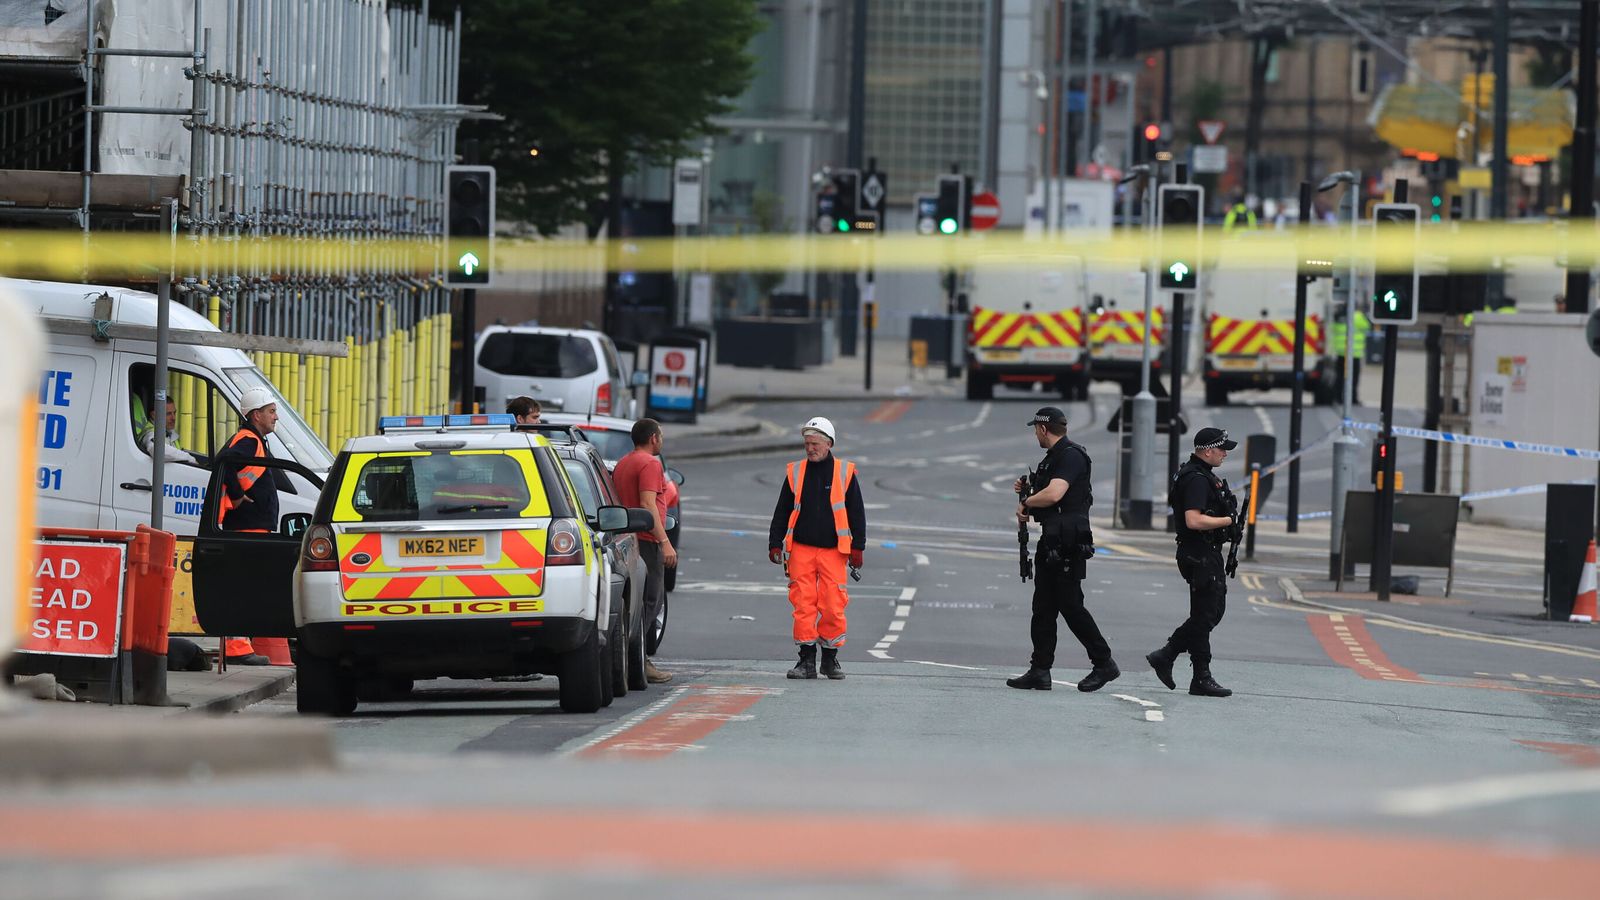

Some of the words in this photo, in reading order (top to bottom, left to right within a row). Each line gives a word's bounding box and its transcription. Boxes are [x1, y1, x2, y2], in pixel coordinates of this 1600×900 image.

[38, 370, 72, 407] TE
[36, 466, 62, 490] 91
[163, 484, 199, 500] FLOOR
[405, 540, 445, 555] MX62
[449, 538, 479, 554] NEF
[31, 558, 81, 579] AD
[29, 588, 92, 610] EAD
[345, 601, 539, 615] POLICE
[31, 618, 99, 641] SED
